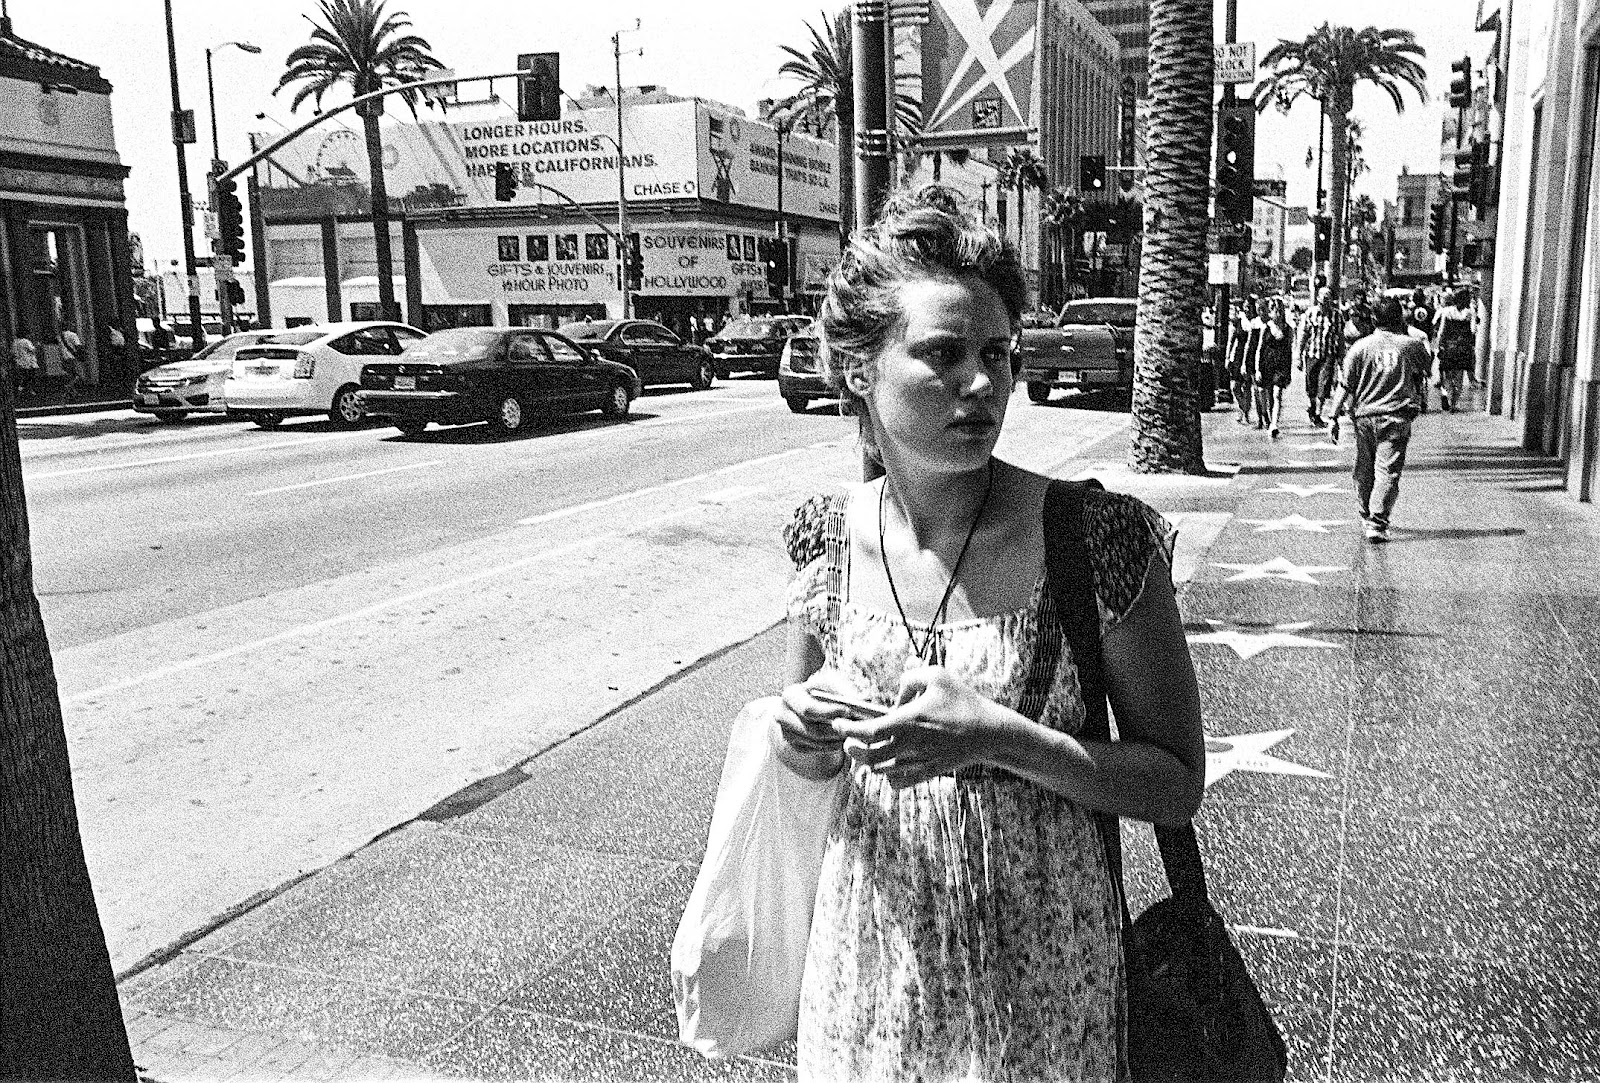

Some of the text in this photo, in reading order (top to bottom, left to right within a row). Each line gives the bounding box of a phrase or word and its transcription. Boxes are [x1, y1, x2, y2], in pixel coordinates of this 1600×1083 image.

[464, 120, 588, 141] LONGER HOURS.
[465, 138, 604, 159] MORE LOCATIONS.
[466, 154, 658, 178] HAPER CALIFORNIANS.
[633, 181, 681, 196] CHASE
[643, 234, 726, 250] SOUVENIRS
[486, 262, 533, 277] GIFTS
[547, 262, 605, 276] SOUVENIRS
[677, 255, 700, 268] OF
[548, 276, 589, 292] PHOTO
[644, 275, 727, 289] HOLLYWOOD
